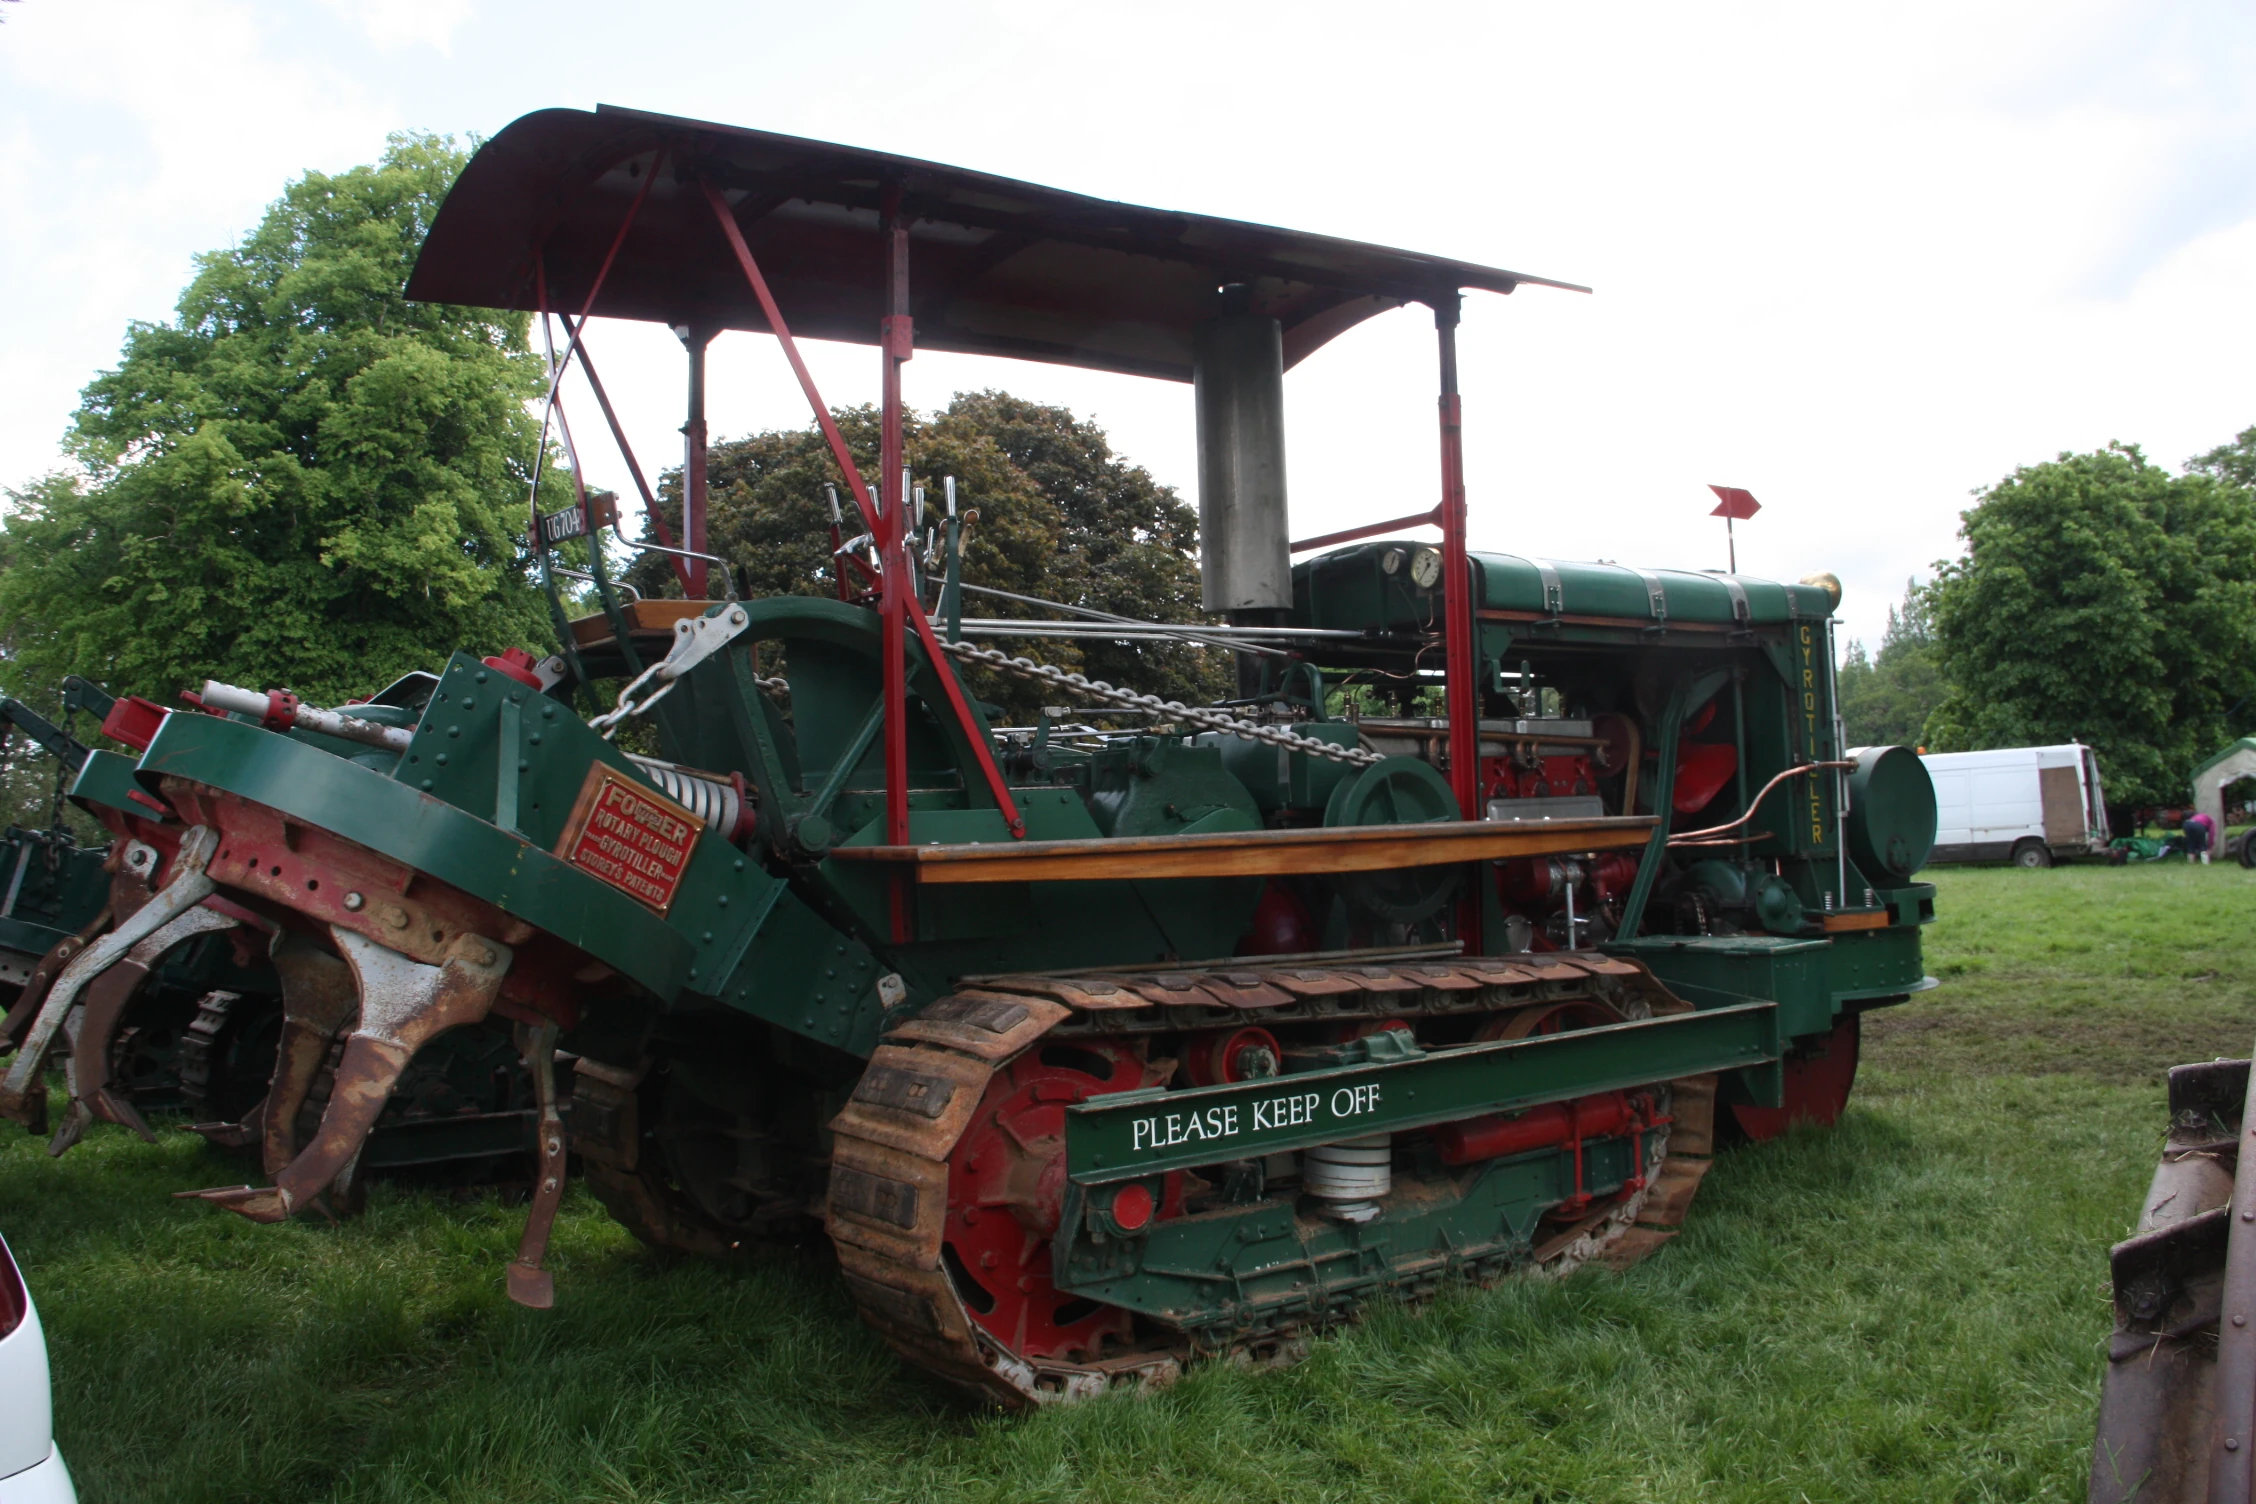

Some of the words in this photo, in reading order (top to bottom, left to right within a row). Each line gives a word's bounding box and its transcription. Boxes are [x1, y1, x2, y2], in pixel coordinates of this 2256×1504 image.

[546, 516, 560, 541] UG
[561, 508, 580, 536] 704
[595, 808, 641, 842] ROTARY
[639, 832, 683, 867] PLOUGH
[600, 834, 664, 880] GYROTILLER
[579, 848, 624, 880] STOREY'S
[624, 871, 665, 902] PATENTS
[1132, 1105, 1239, 1150] PLEASE
[1252, 1093, 1320, 1131] KEEP
[1331, 1083, 1381, 1117] OFF
